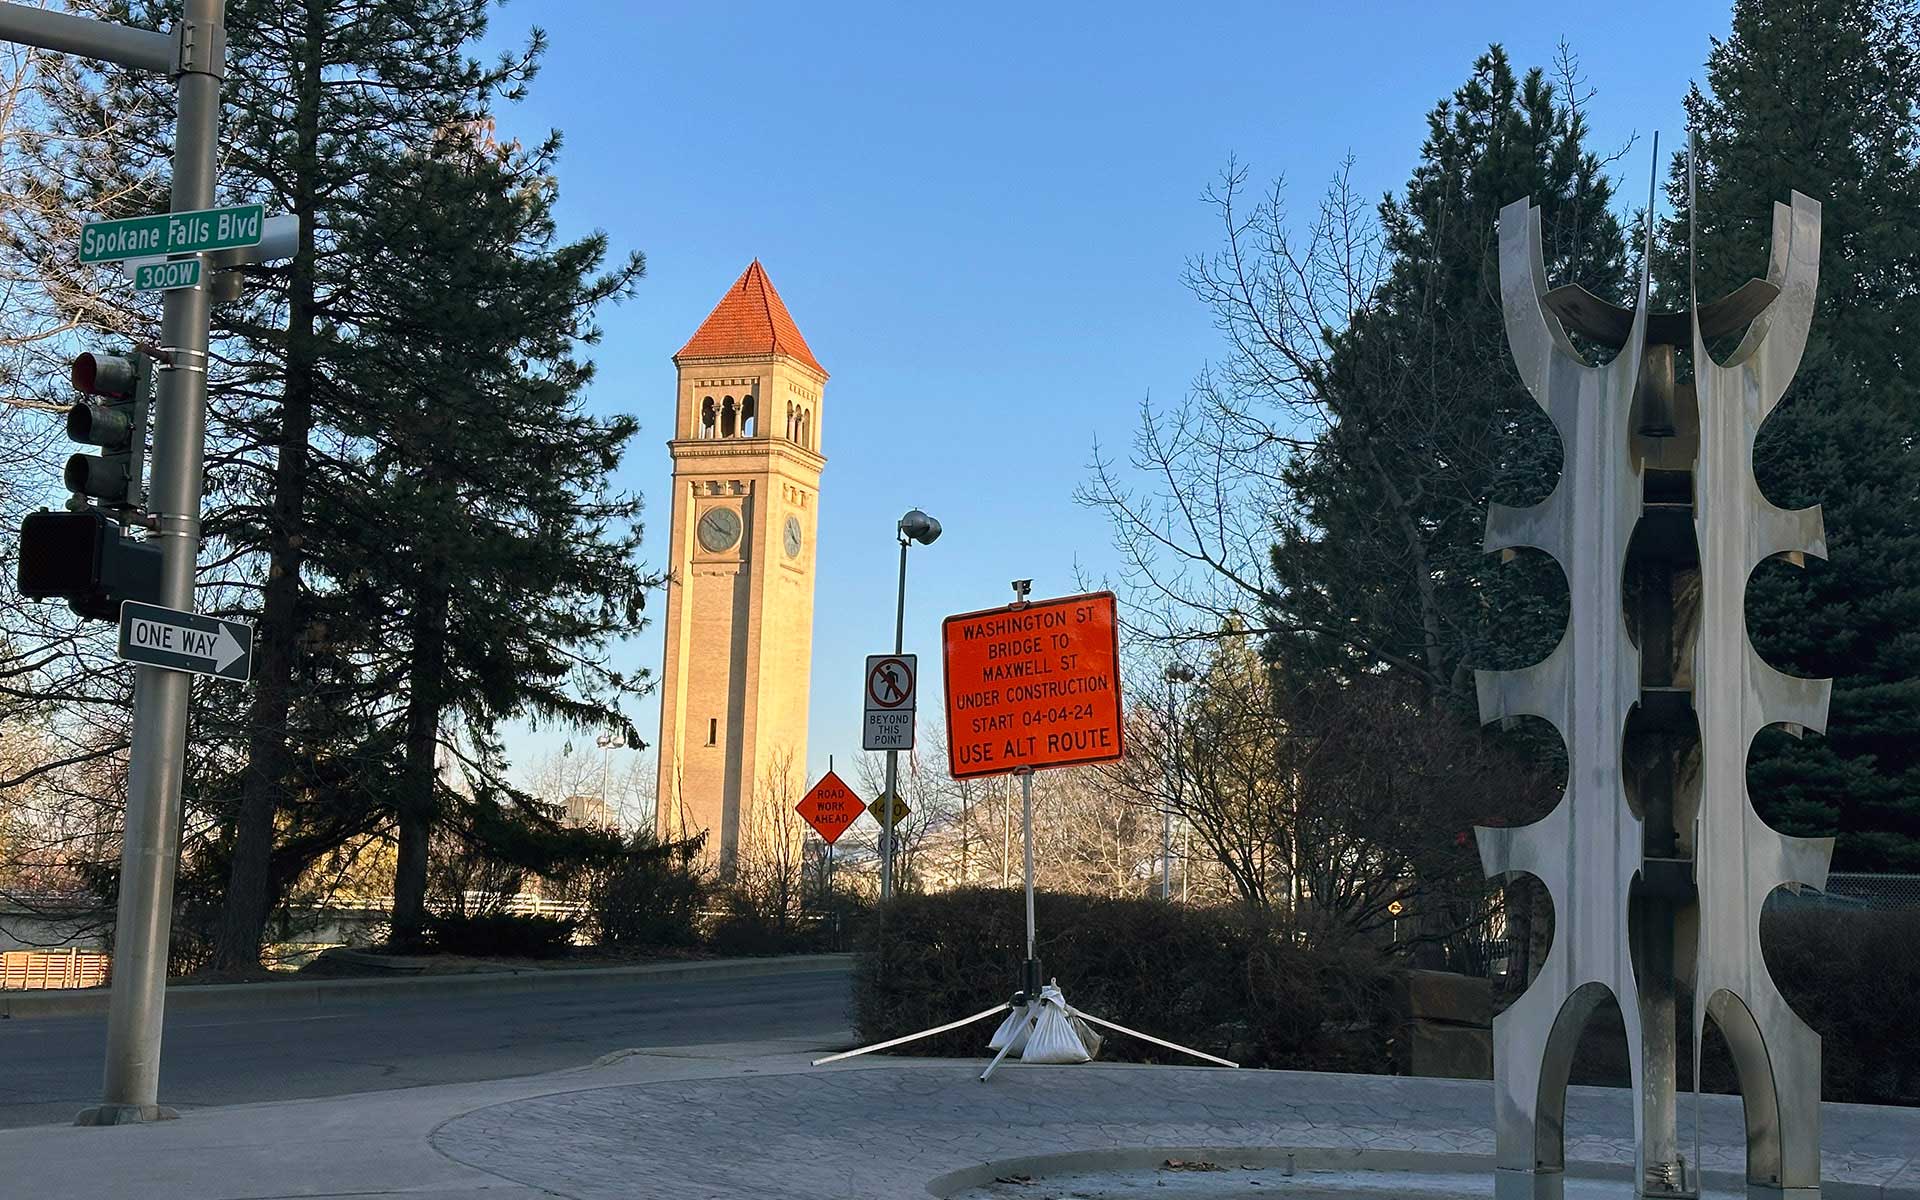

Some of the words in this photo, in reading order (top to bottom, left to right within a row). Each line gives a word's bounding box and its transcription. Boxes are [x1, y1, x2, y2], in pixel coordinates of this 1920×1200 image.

[83, 226, 160, 257] Spokane
[167, 217, 210, 246] Falls
[217, 211, 258, 241] Blvd
[142, 263, 194, 288] 300W
[963, 611, 1066, 640] WASHINGTON
[1076, 606, 1094, 623] ST
[136, 622, 173, 649] ONE
[182, 631, 217, 656] WAY
[988, 637, 1042, 659] BRIDGE
[1052, 633, 1070, 650] TO
[983, 659, 1052, 682] MAXWELL
[1060, 654, 1078, 671] ST
[956, 689, 1000, 710] UNDER
[1006, 674, 1108, 704] CONSTRUCTION
[870, 715, 909, 725] BEYOND
[879, 725, 900, 734] THIS
[972, 713, 1015, 734] START
[1022, 704, 1093, 726] 04-04-24
[874, 735, 902, 745] POINT
[959, 743, 993, 764] USE
[1003, 736, 1037, 759] ALT
[1048, 727, 1111, 753] ROUTE
[817, 789, 845, 799] ROAD
[817, 801, 845, 811] WORK
[813, 814, 849, 824] AHEAD
